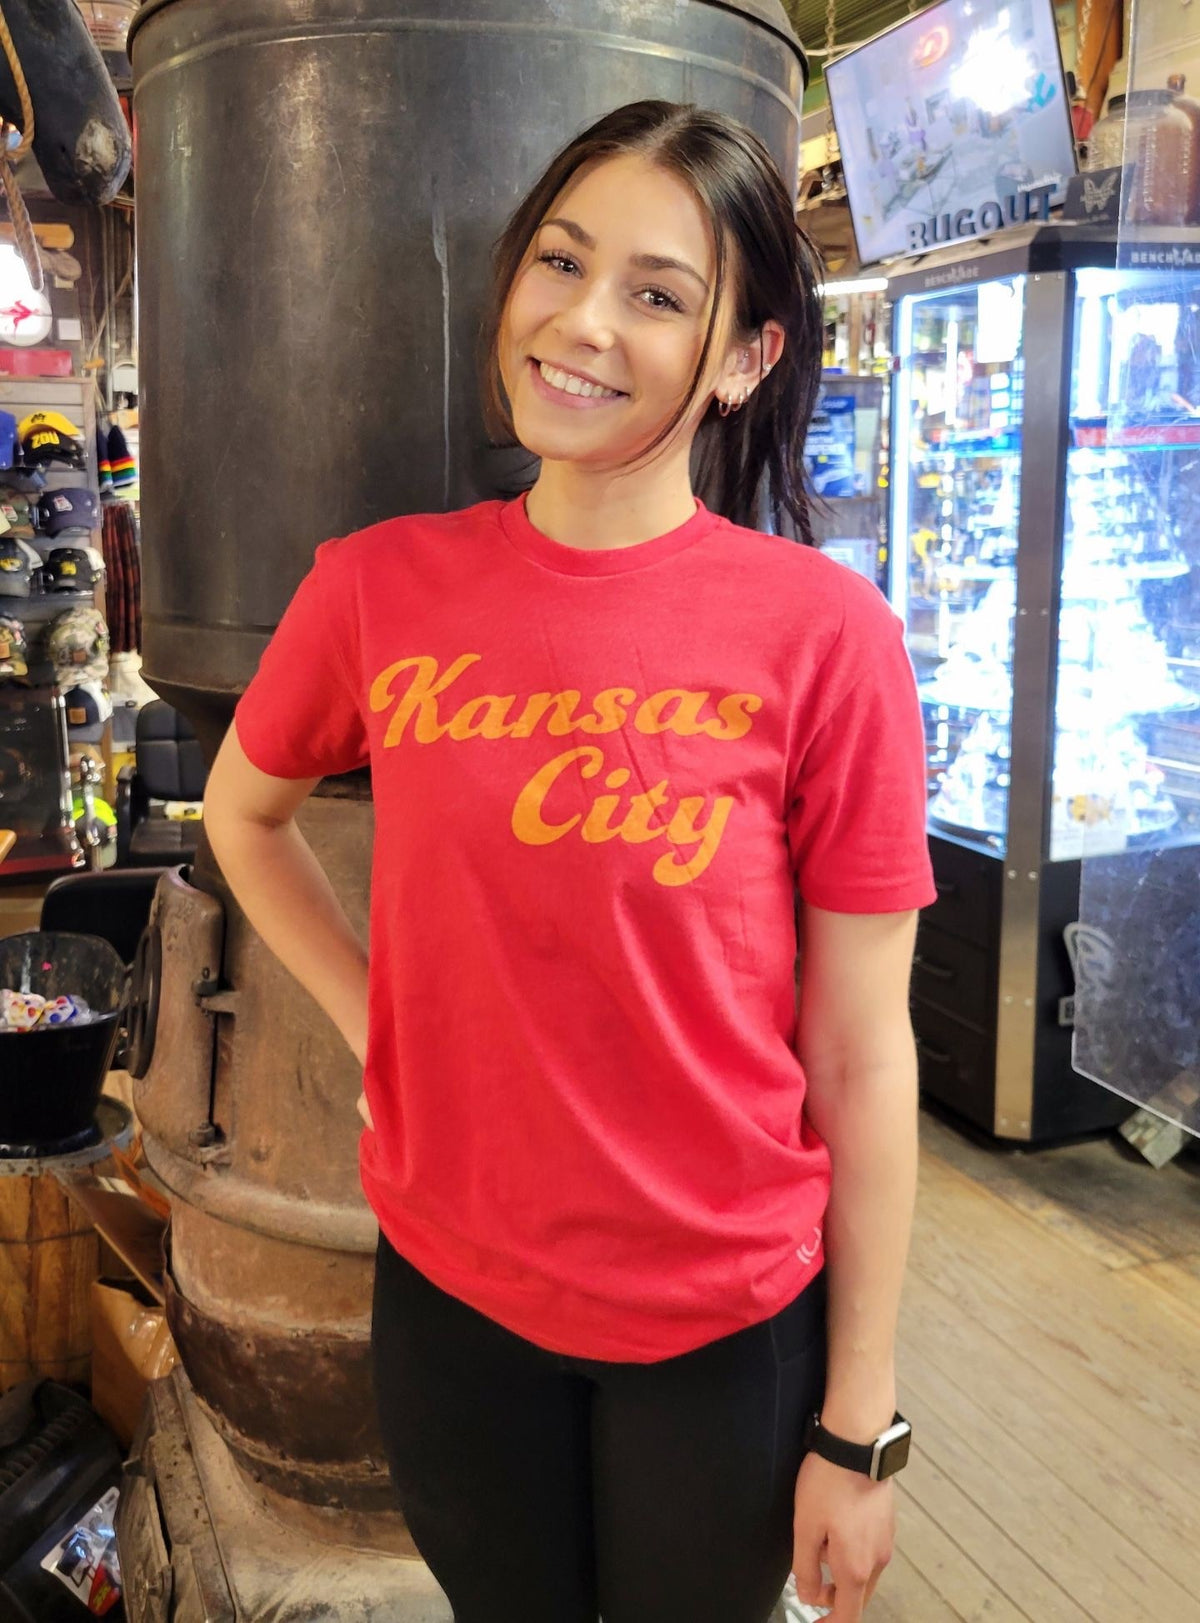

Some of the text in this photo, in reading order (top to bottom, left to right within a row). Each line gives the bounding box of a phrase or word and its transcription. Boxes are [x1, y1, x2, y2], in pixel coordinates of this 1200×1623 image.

[905, 183, 1057, 251] BUGOUT
[31, 431, 60, 449] ZOU
[369, 653, 763, 748] Kansas
[511, 746, 735, 887] City
